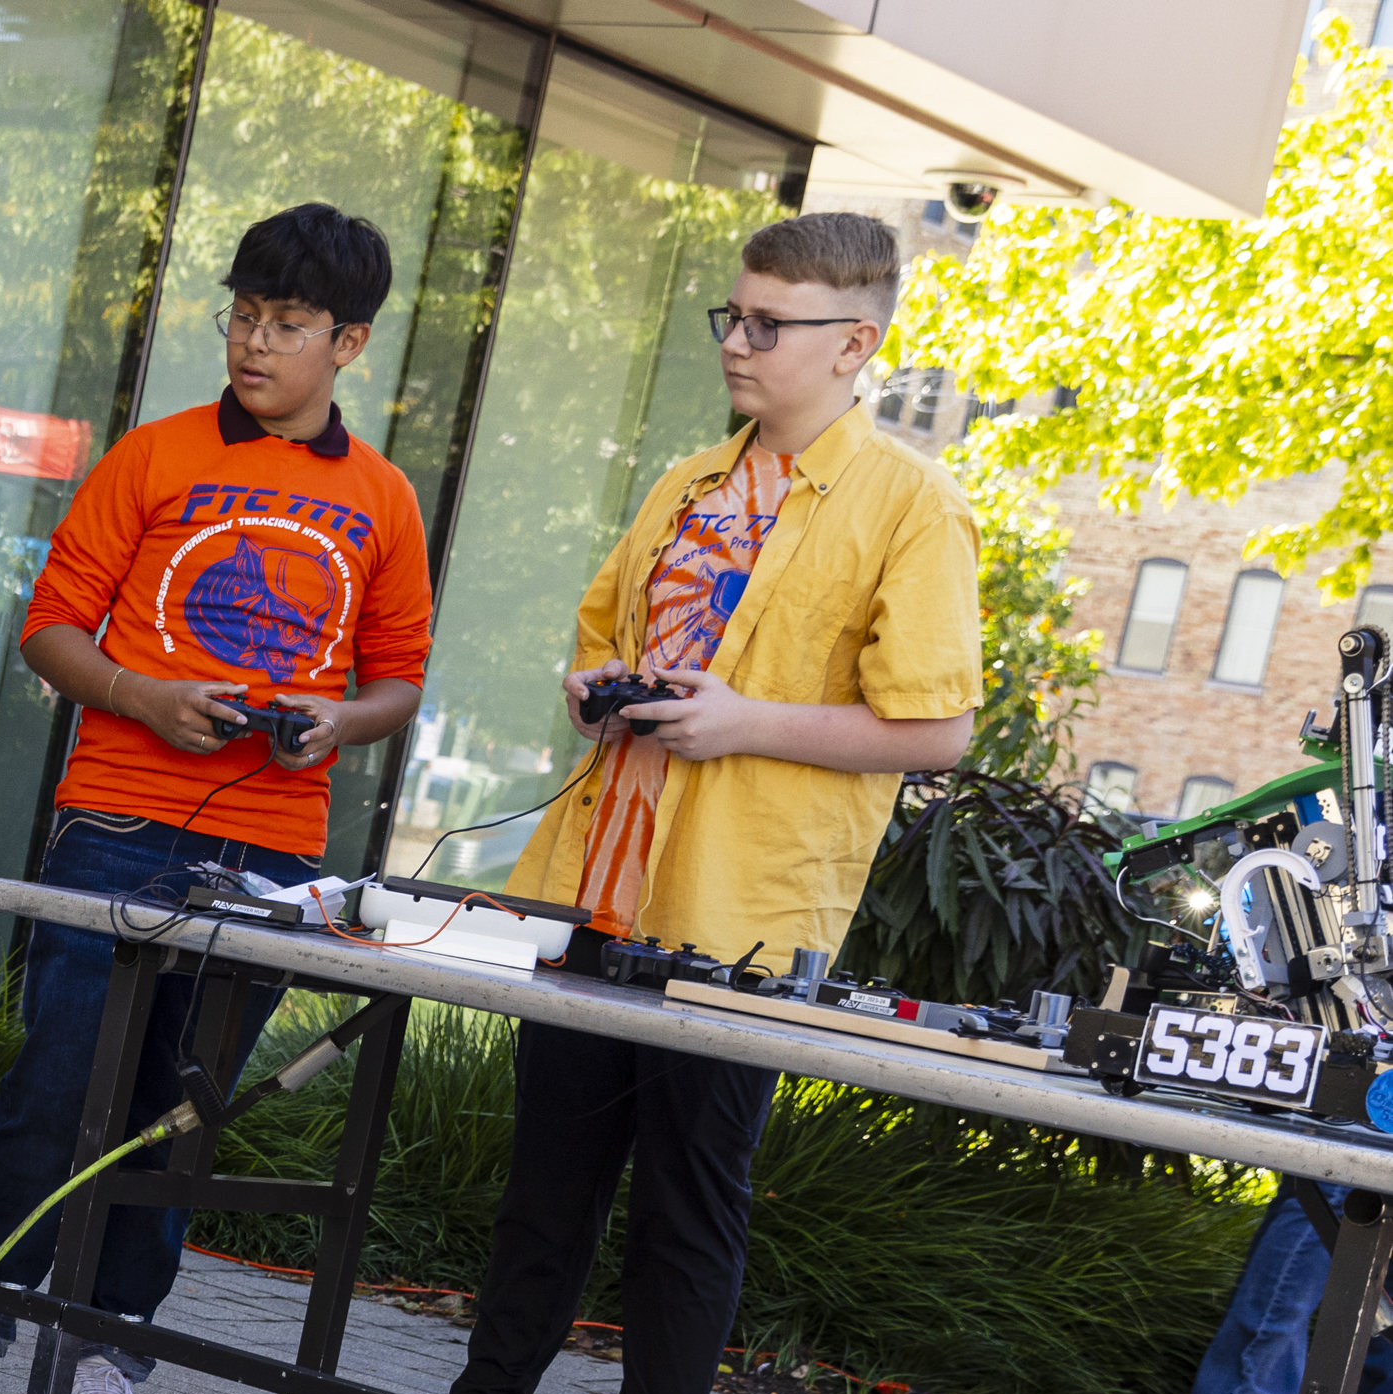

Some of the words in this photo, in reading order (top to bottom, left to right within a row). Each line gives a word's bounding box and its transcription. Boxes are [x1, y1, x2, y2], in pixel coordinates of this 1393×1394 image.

[169, 518, 233, 568] NOTORIOUSLY
[238, 516, 301, 532] TENACIOUS
[301, 526, 336, 552] HYPER
[332, 550, 350, 580] ELITE
[179, 483, 280, 524] FTC
[286, 494, 373, 552] 7772
[671, 513, 737, 549] FTC
[1146, 1009, 1315, 1094] 5383
